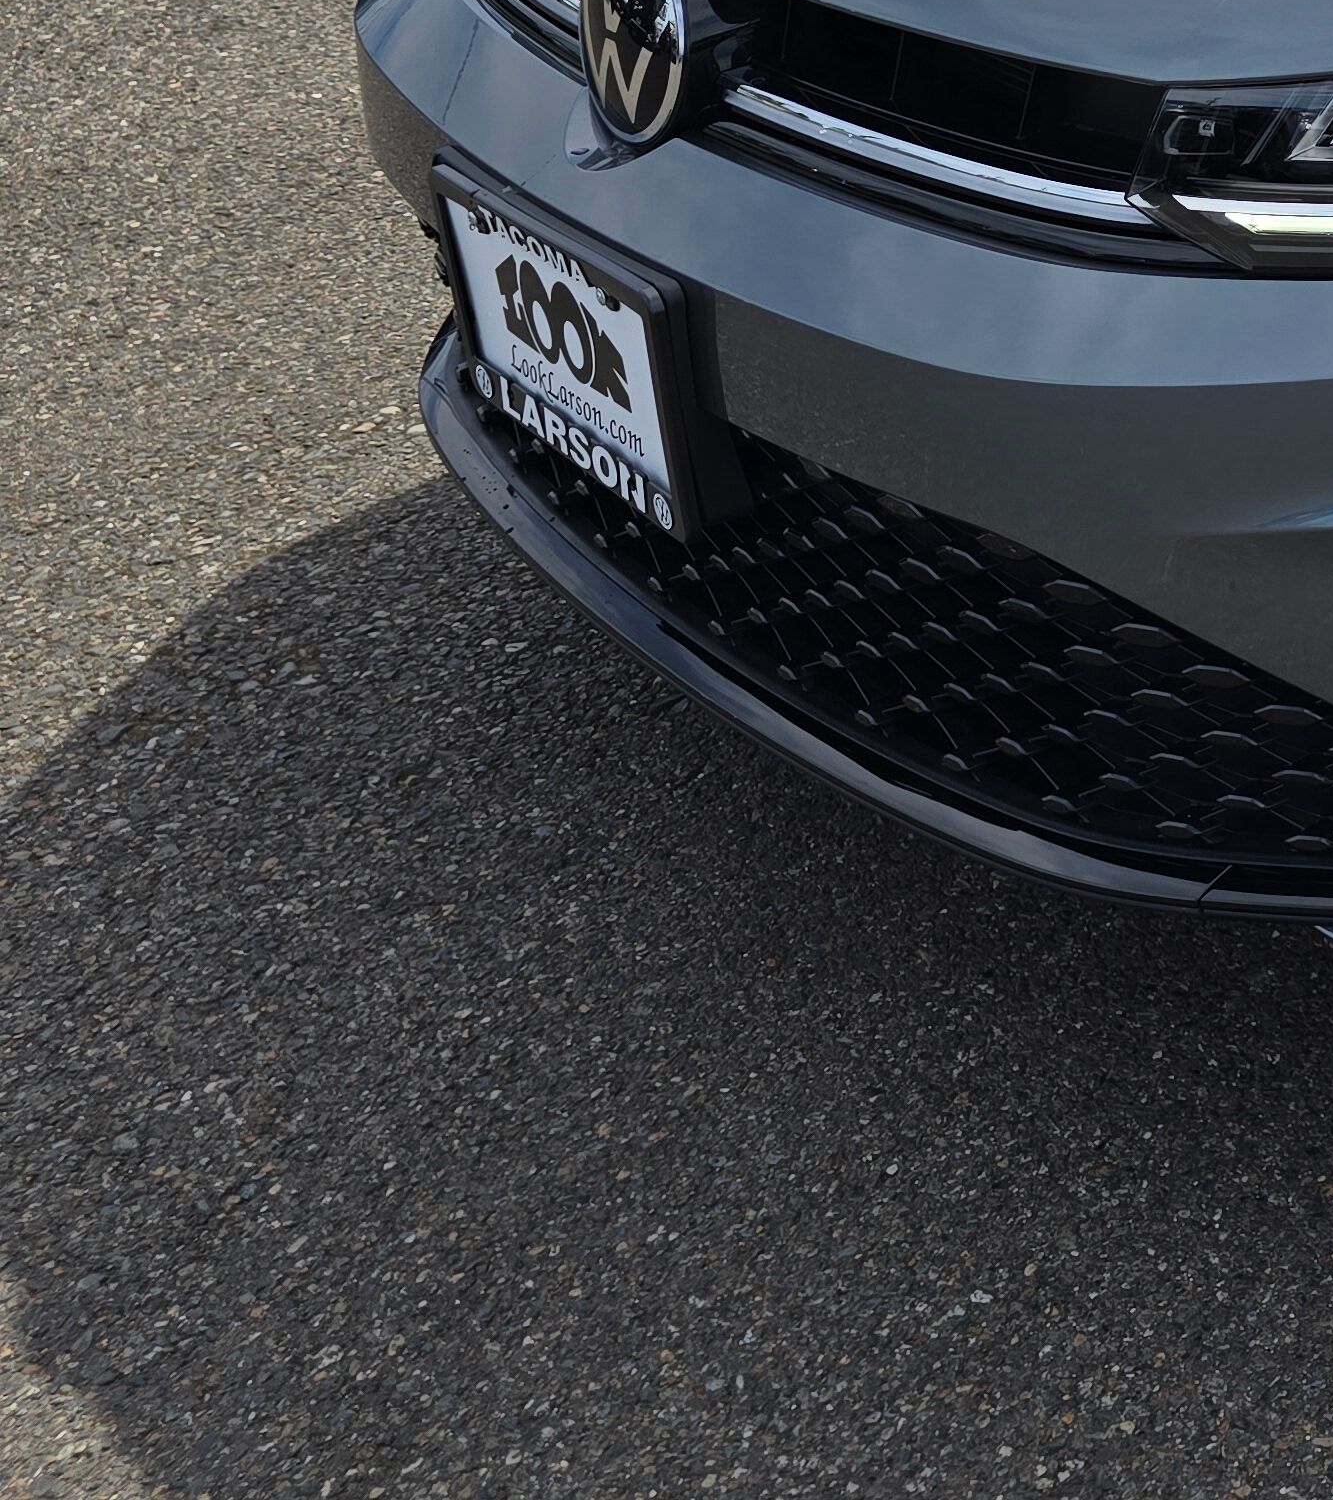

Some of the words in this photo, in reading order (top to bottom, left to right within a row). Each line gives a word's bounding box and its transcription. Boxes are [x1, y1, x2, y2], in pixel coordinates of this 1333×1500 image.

[478, 205, 592, 288] TACOMA
[495, 254, 633, 413] LOOK
[500, 377, 646, 514] LARSON
[510, 344, 645, 458] LookLarson.com
